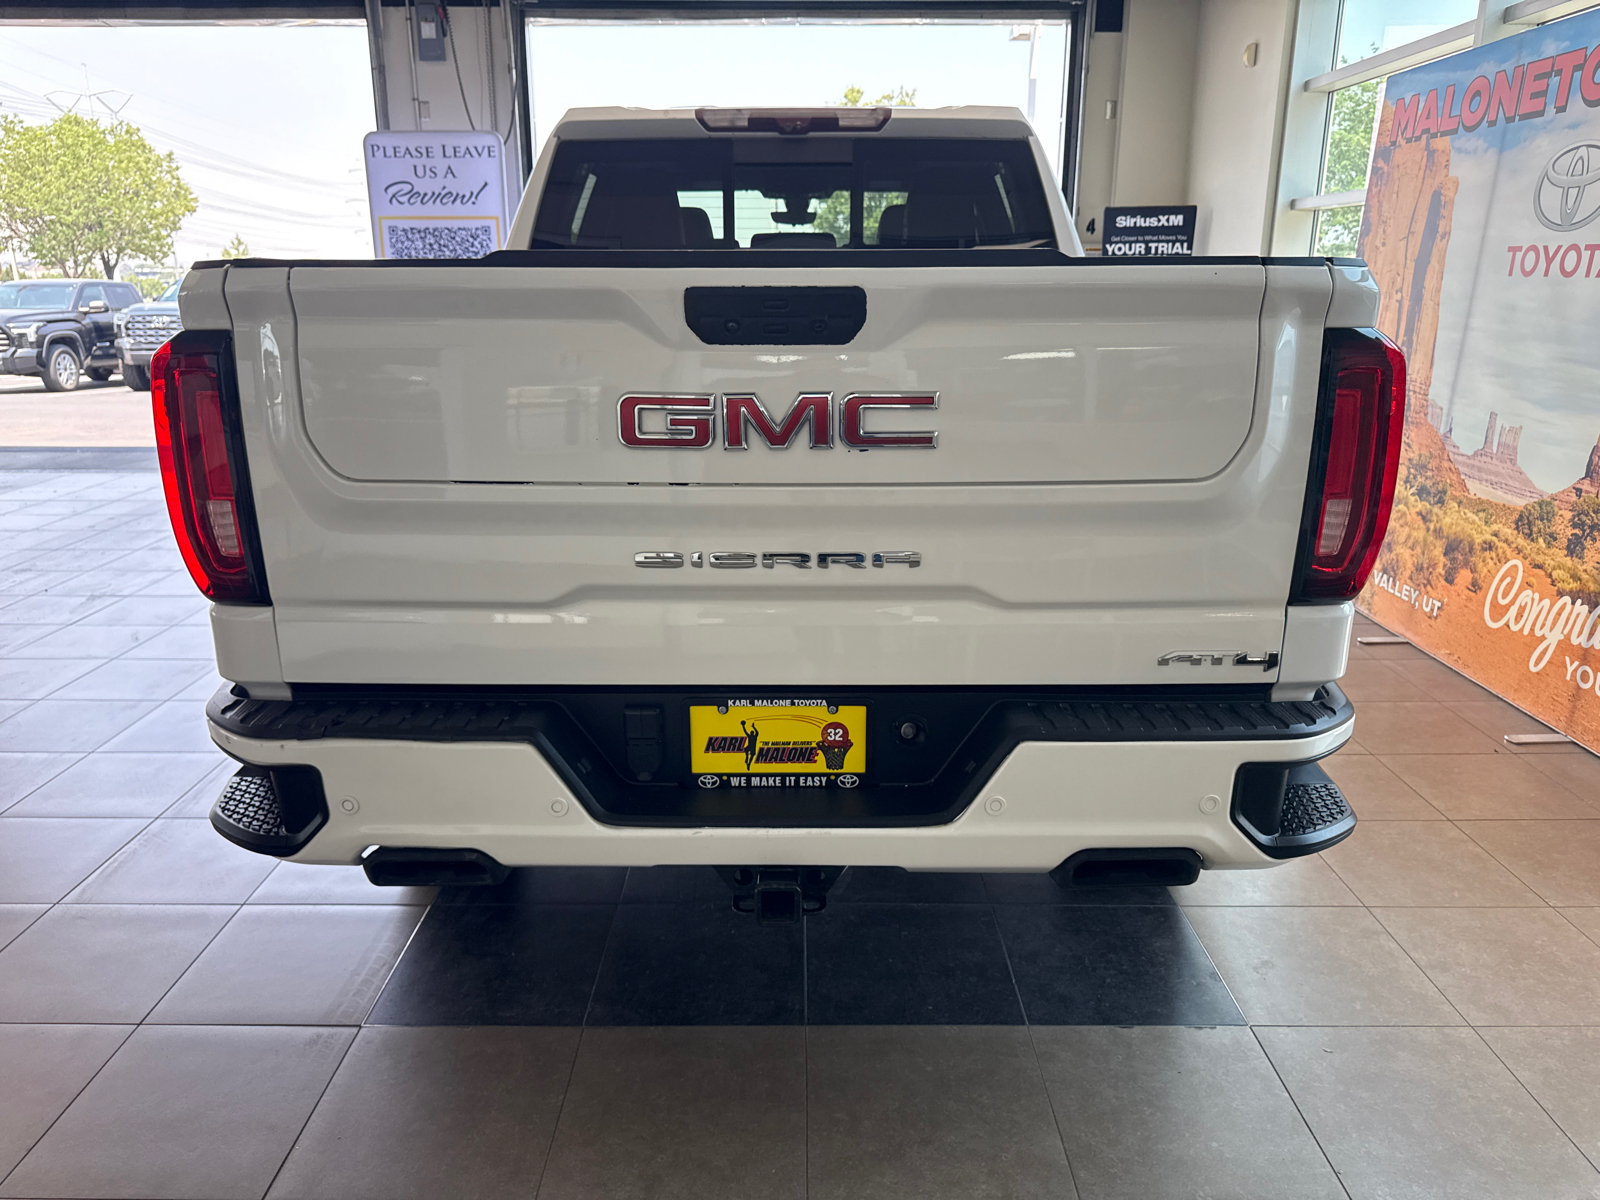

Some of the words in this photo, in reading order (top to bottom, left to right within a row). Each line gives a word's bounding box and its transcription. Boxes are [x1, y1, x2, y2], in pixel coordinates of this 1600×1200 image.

[370, 143, 435, 159] PLEASE
[441, 143, 497, 159] LEAVE
[443, 164, 458, 179] A
[384, 180, 489, 206] Review!
[1085, 217, 1096, 235] 4
[1115, 214, 1184, 228] SiriusXM
[1105, 242, 1146, 256] YOUR
[1148, 242, 1191, 255] TRIAL
[1507, 243, 1600, 278] TOYOT
[616, 390, 940, 450] GMC
[633, 550, 922, 569] SIERRA
[1373, 569, 1419, 609] VALLEY,
[1422, 595, 1442, 617] UT
[1157, 650, 1279, 672] AT4
[728, 699, 752, 707] KARL
[754, 699, 792, 707] MALONE
[793, 699, 828, 707] TOYOTA
[827, 728, 843, 741] 32
[704, 736, 748, 753] KARL
[754, 746, 819, 764] MALONE
[730, 776, 747, 787] WE
[751, 776, 782, 787] MAKE
[785, 776, 796, 787] IT
[799, 776, 827, 787] EASY
